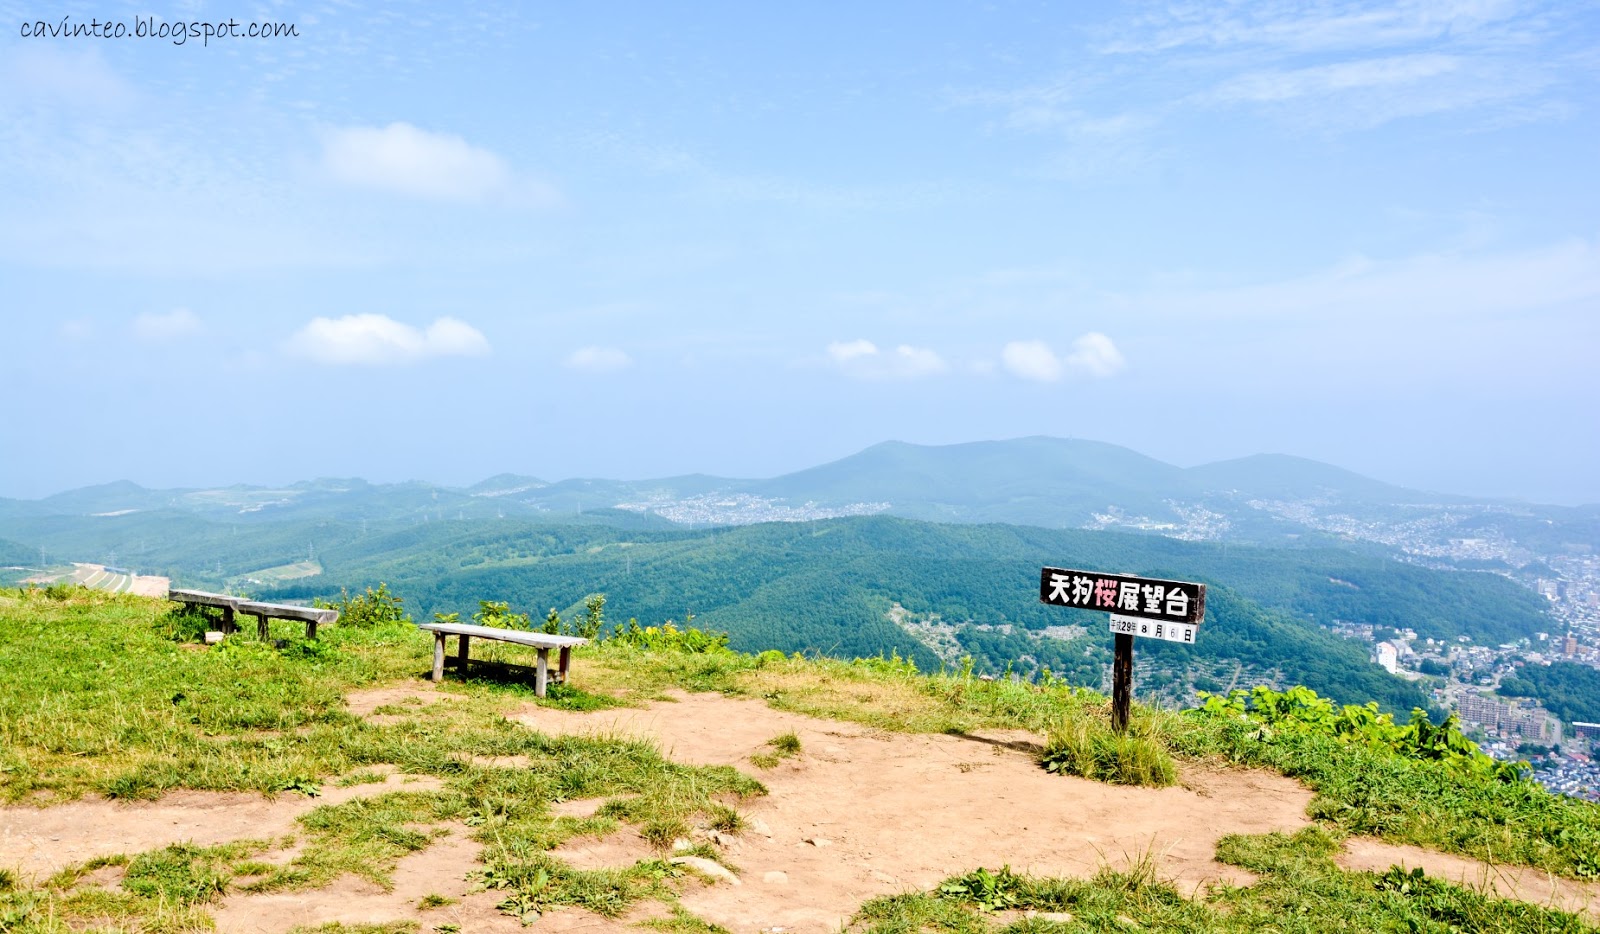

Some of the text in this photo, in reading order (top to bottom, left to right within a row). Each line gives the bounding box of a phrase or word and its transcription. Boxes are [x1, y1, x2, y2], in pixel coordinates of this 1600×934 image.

[1048, 573, 1189, 616] 天狗桜展望台
